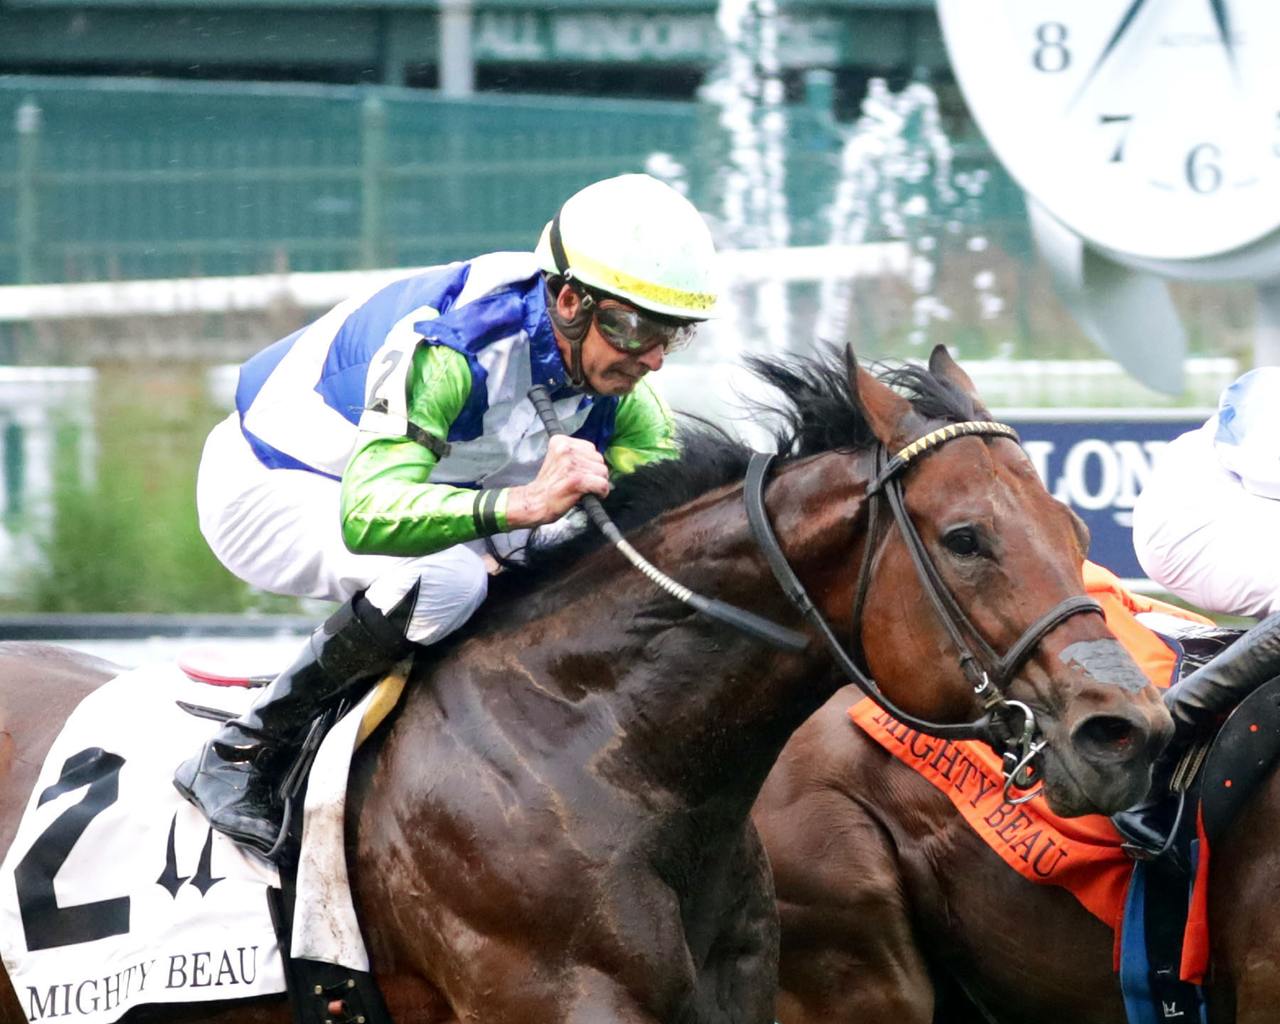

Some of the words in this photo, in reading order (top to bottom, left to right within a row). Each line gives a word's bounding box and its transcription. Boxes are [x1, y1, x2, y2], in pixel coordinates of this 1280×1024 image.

[1031, 21, 1072, 74] 8
[1099, 113, 1133, 163] 7
[1184, 143, 1223, 194] 6
[13, 746, 131, 952] 2
[983, 802, 1068, 878] BEAU
[26, 959, 156, 1022] MIGHTY
[165, 945, 259, 989] BEAU
